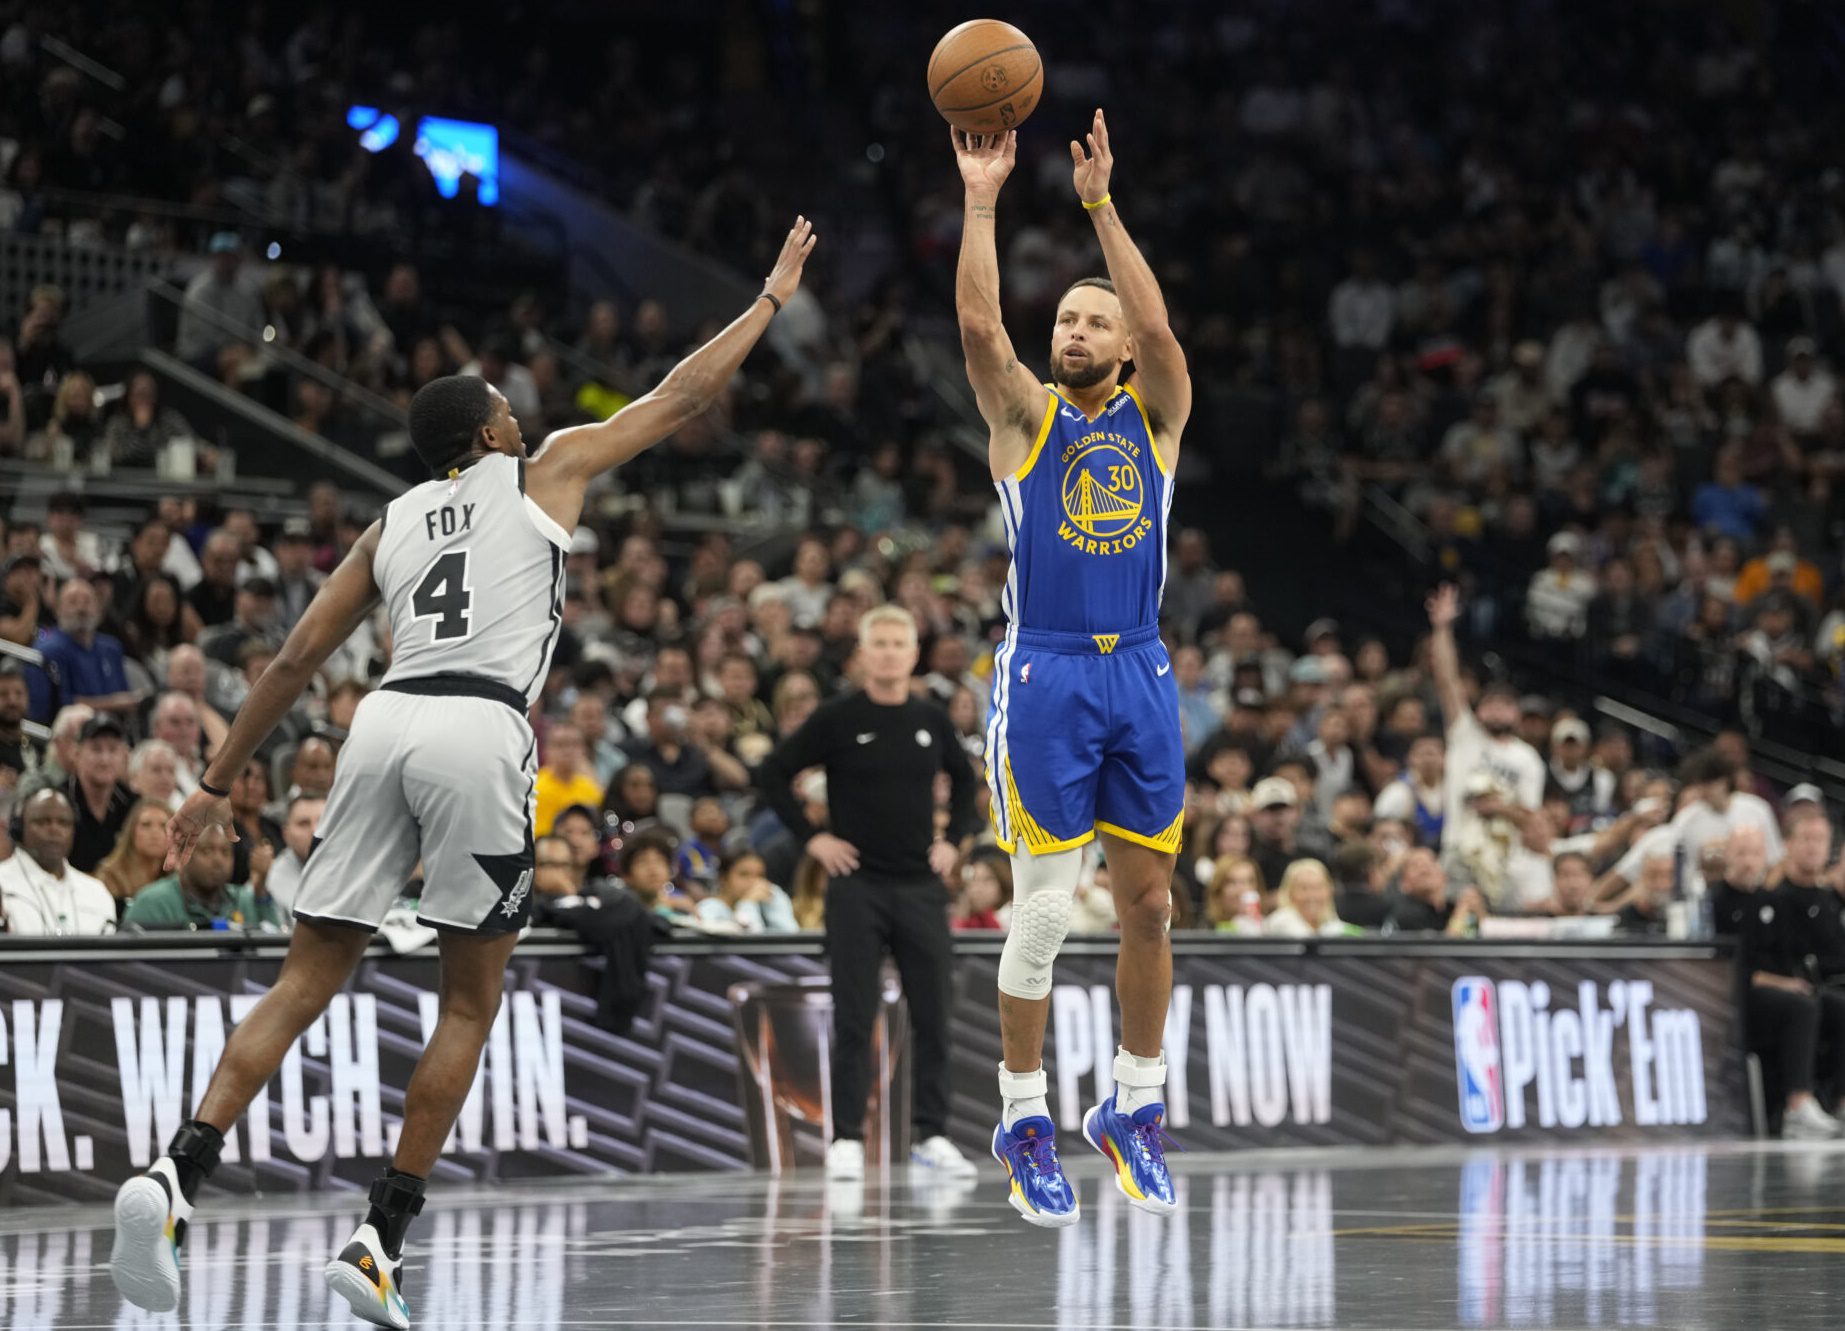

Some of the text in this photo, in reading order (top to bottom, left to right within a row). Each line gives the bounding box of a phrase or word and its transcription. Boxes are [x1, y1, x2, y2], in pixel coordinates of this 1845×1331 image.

[1062, 431, 1141, 463] GOLDEN STATE
[1108, 465, 1135, 492] 30
[425, 503, 475, 541] FOX
[1057, 516, 1153, 555] WARRIORS
[408, 547, 475, 644] 4
[0, 998, 94, 1174] K.
[417, 990, 588, 1154] IN.
[1052, 982, 1333, 1131] PLY NOW
[1497, 978, 1708, 1129] Pick'Em
